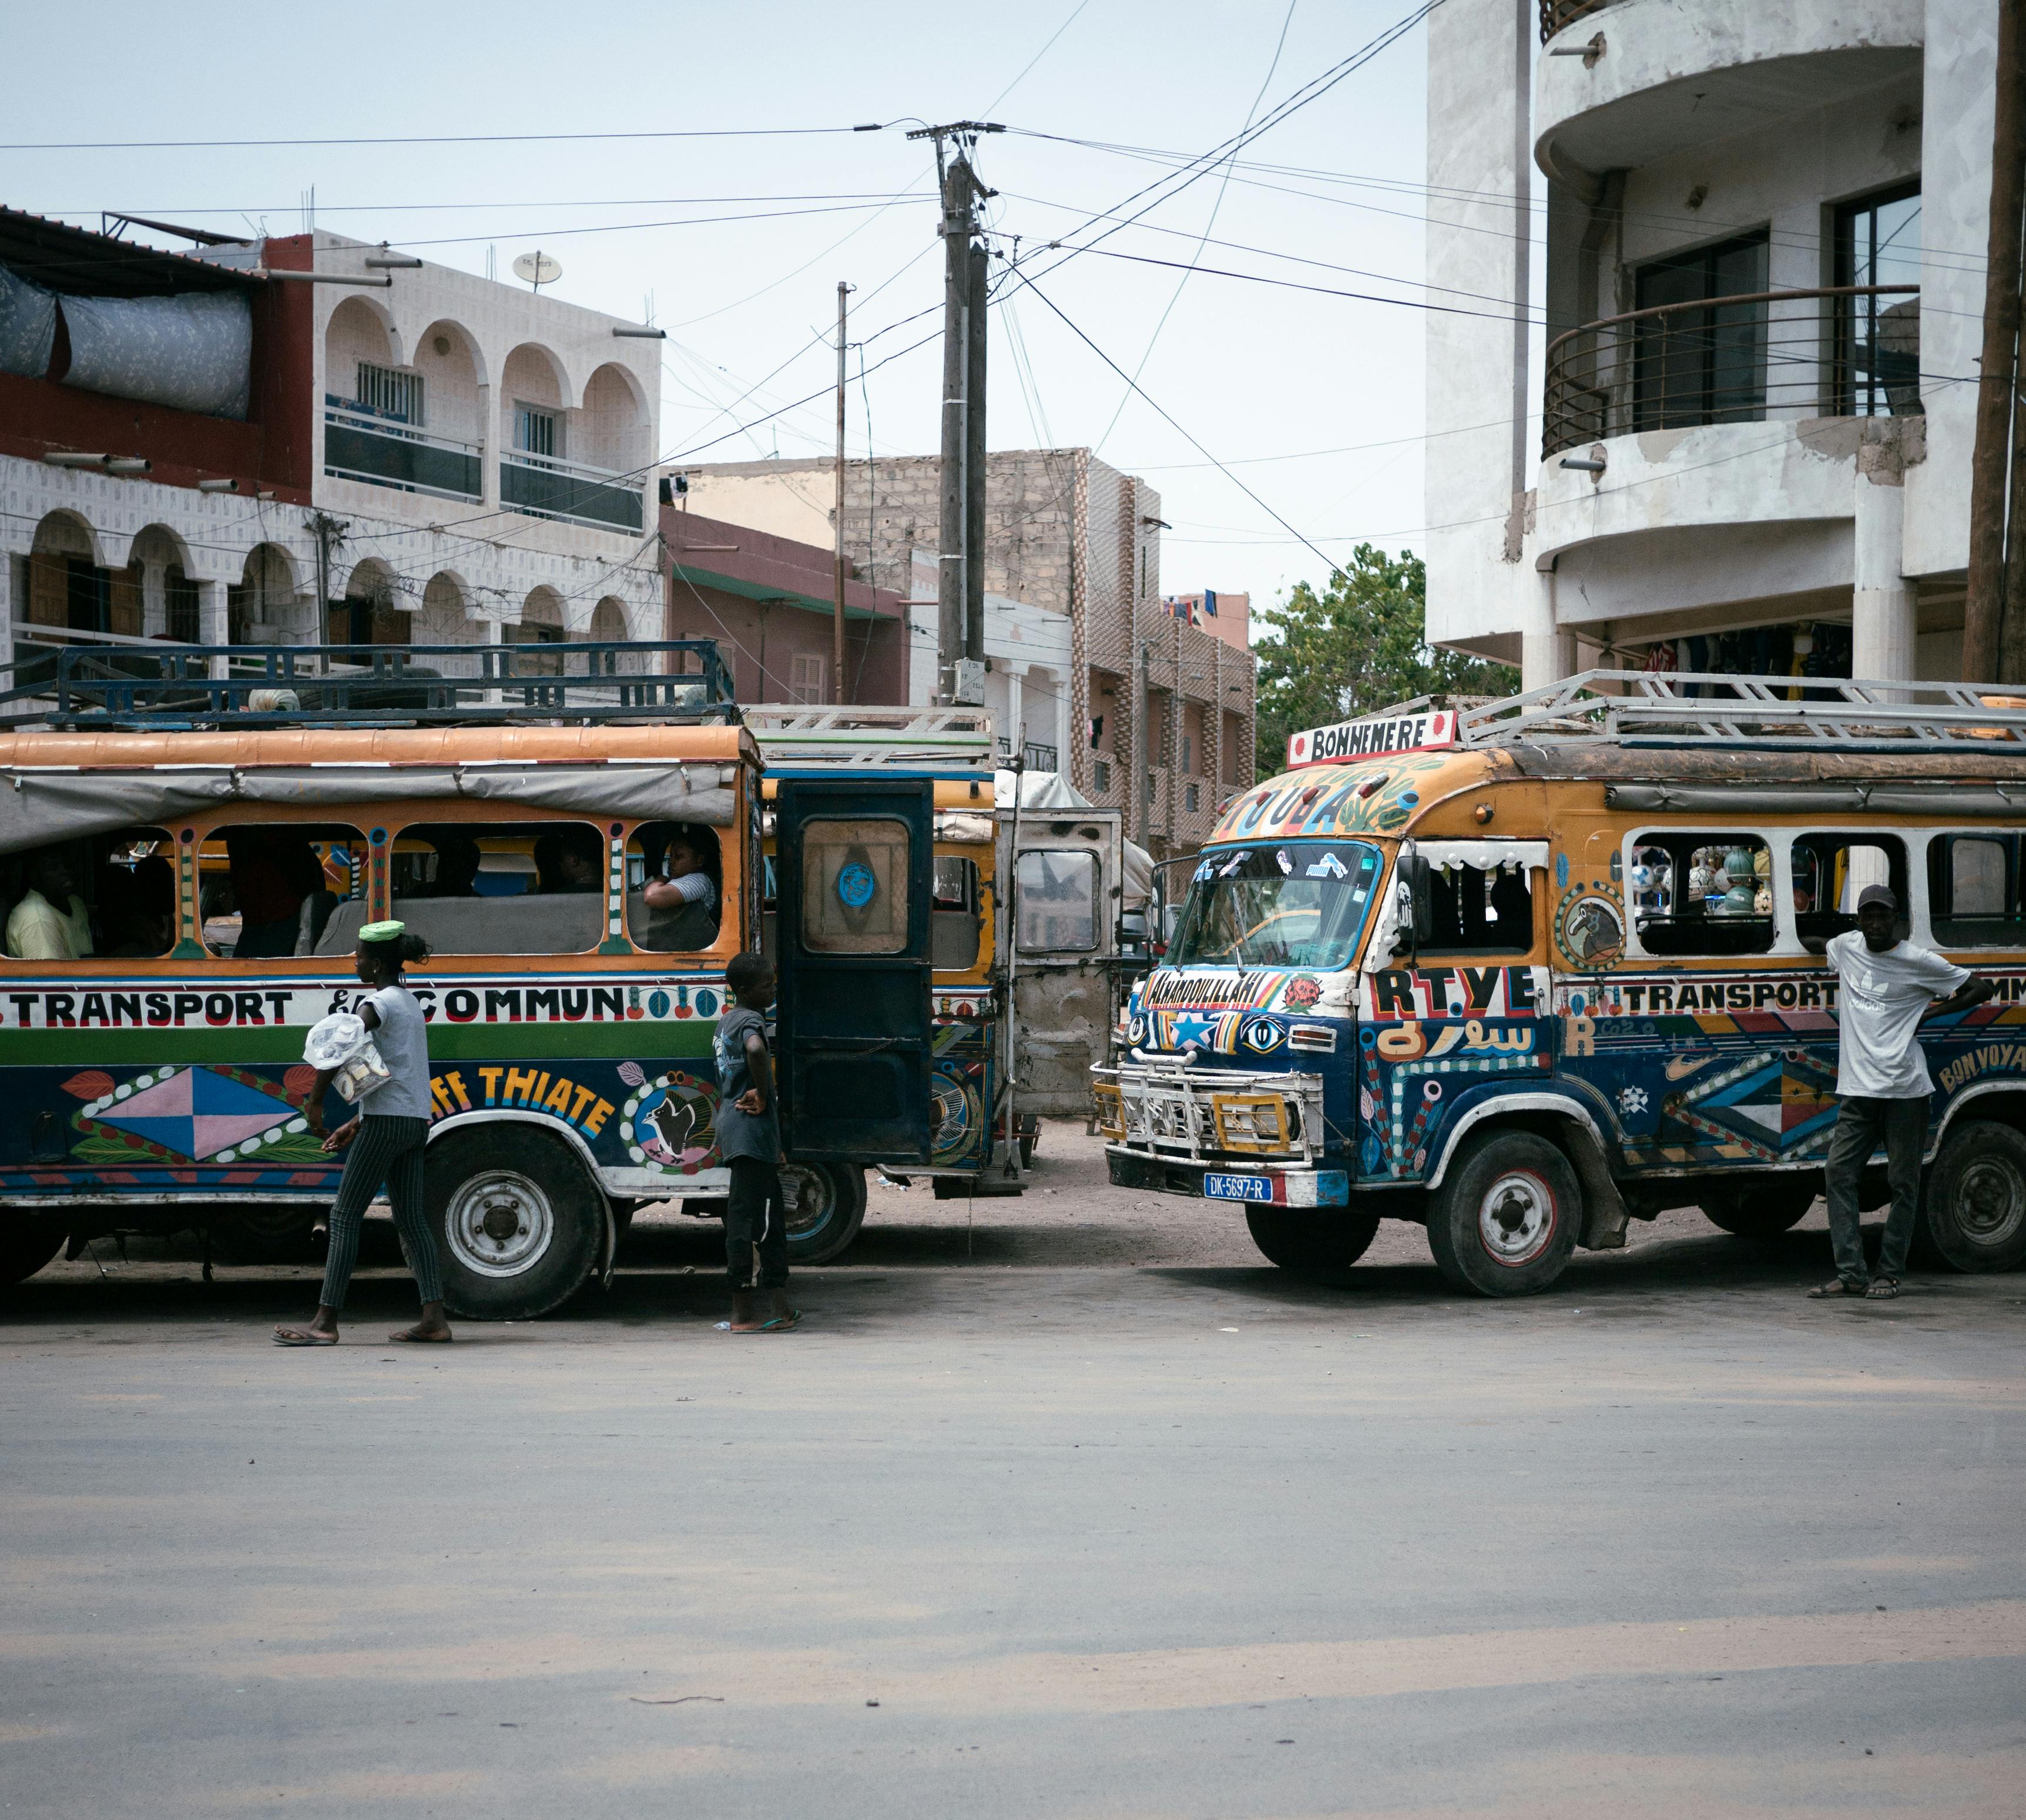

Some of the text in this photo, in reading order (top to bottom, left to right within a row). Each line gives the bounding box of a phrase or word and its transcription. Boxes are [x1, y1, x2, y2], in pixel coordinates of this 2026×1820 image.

[1218, 783, 1361, 840] TOUBA
[1307, 865, 1329, 875] PUMA
[9, 992, 293, 1027] TRANSPORT
[412, 988, 625, 1023] COMMUN
[1623, 982, 1839, 1015] TRANSPORT
[479, 1067, 615, 1140] THIATE
[1210, 1176, 1263, 1199] DK-5697-R
